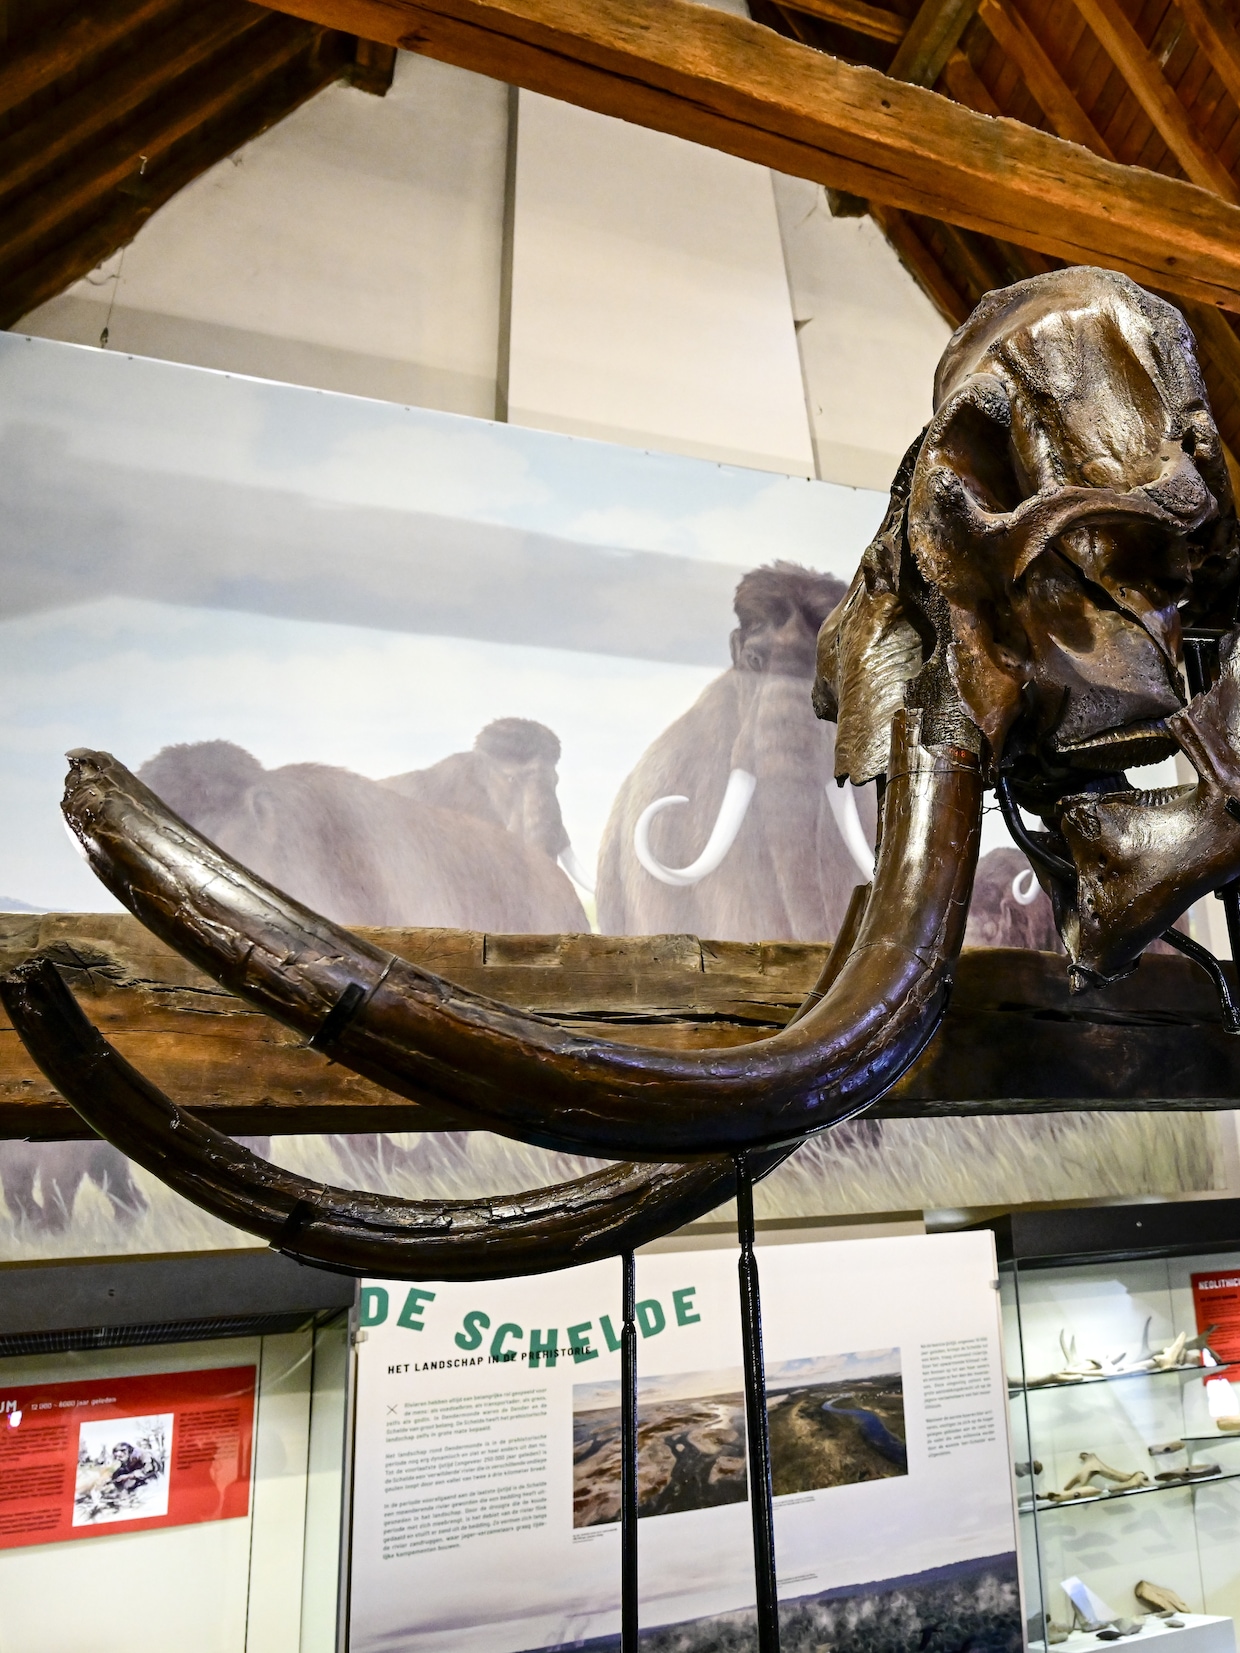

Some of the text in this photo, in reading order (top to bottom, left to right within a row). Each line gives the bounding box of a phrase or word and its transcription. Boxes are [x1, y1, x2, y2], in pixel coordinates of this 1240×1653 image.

[361, 1286, 701, 1368] DE SCHELDE
[388, 1346, 591, 1374] HET LANDSCHAP IN DE PREHISTORIE
